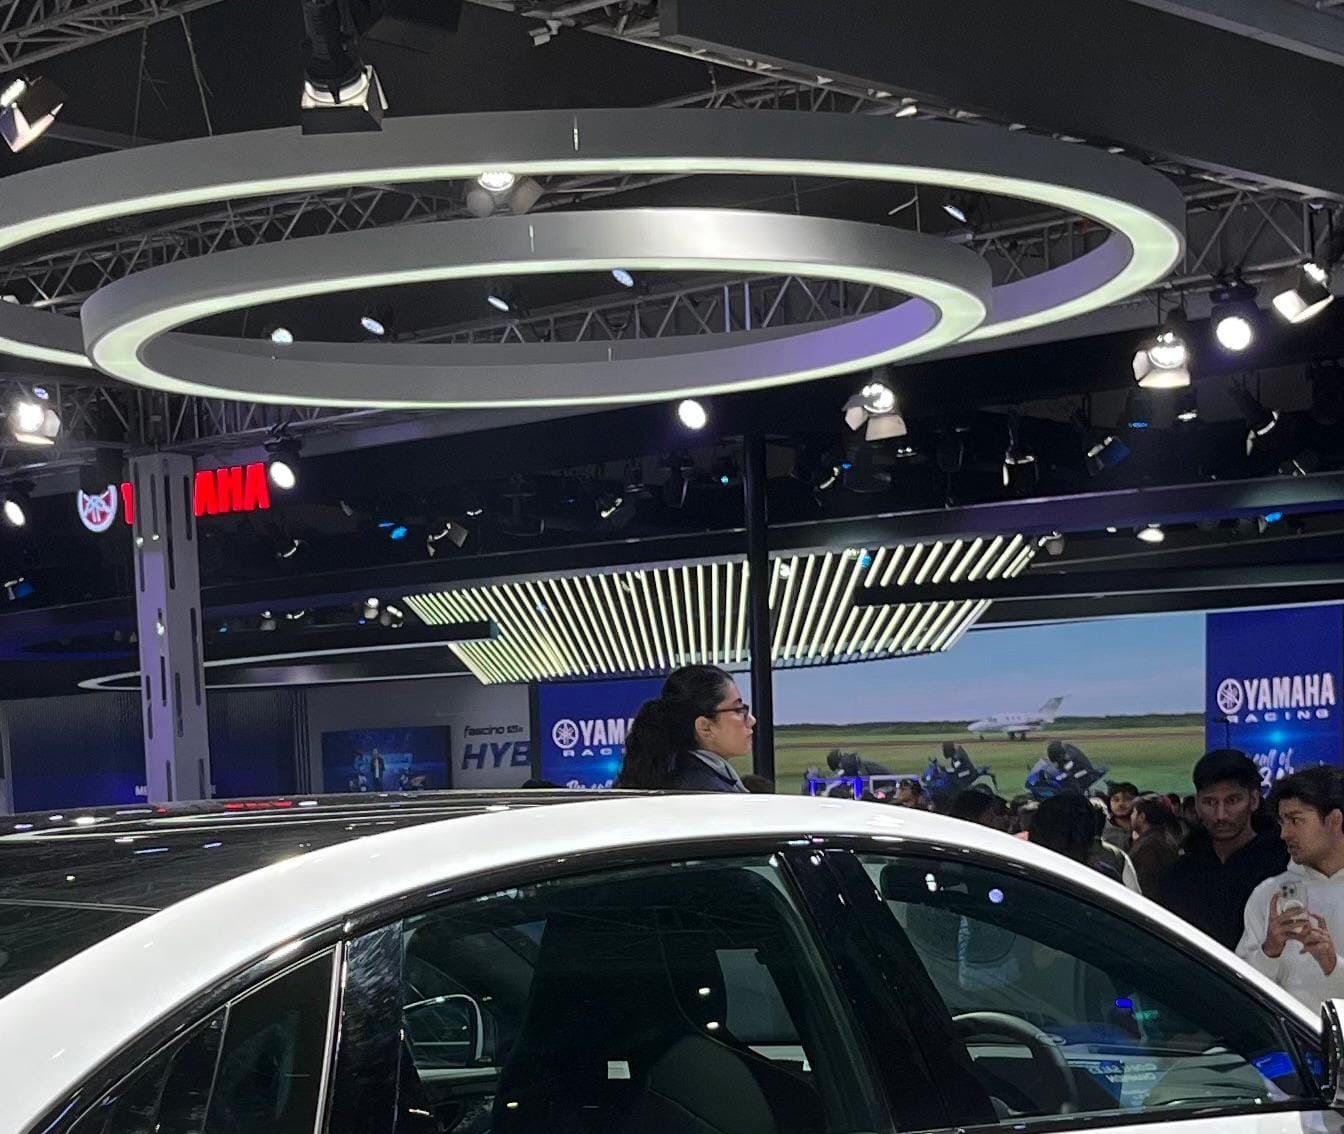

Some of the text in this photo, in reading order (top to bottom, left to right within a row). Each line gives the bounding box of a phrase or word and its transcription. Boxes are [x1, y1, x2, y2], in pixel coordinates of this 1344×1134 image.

[1244, 672, 1336, 711] YAMAHA
[1226, 708, 1330, 723] RACING
[464, 725, 504, 739] fascino
[579, 718, 635, 747] YAM
